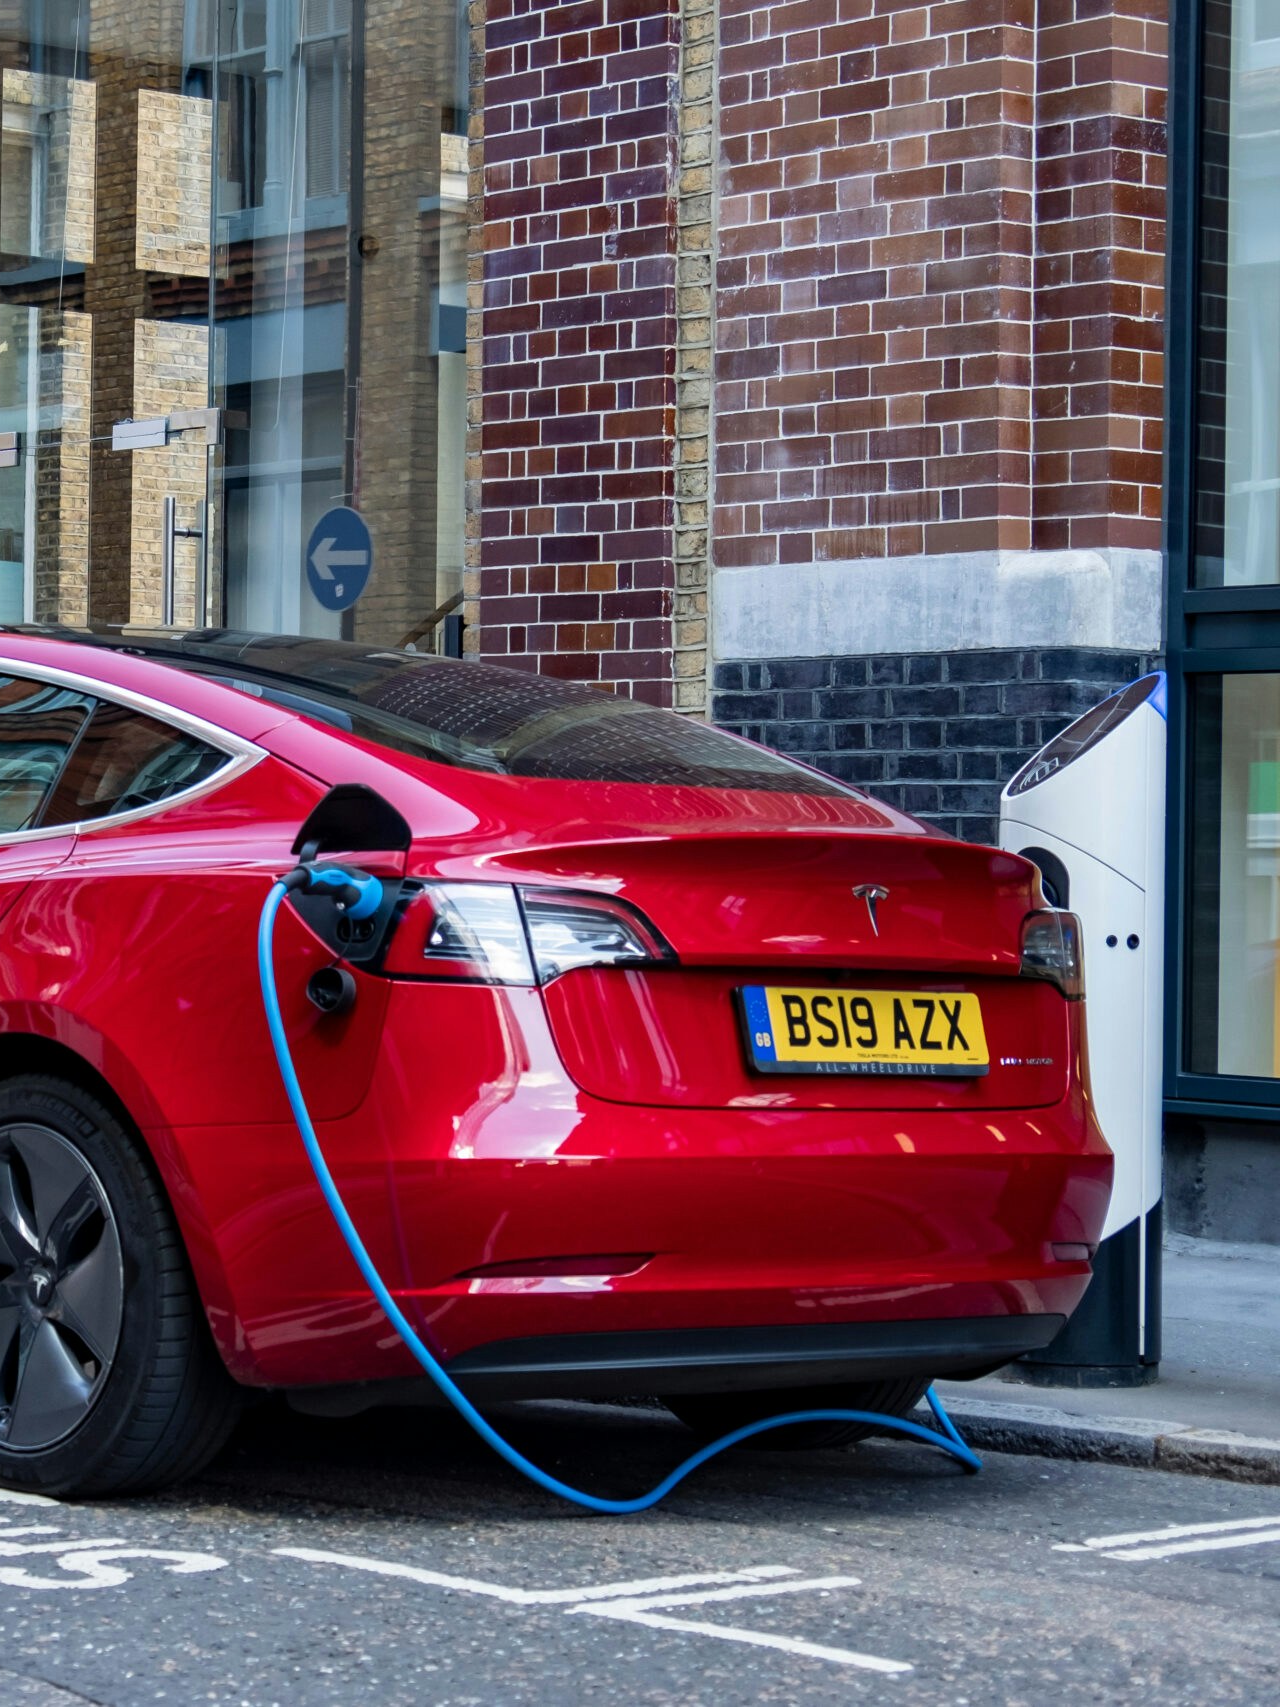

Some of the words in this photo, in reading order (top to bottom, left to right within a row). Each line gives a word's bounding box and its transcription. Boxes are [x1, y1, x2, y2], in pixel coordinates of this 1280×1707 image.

[755, 1032, 772, 1047] GB
[781, 994, 879, 1049] BS19
[893, 998, 970, 1051] AZX
